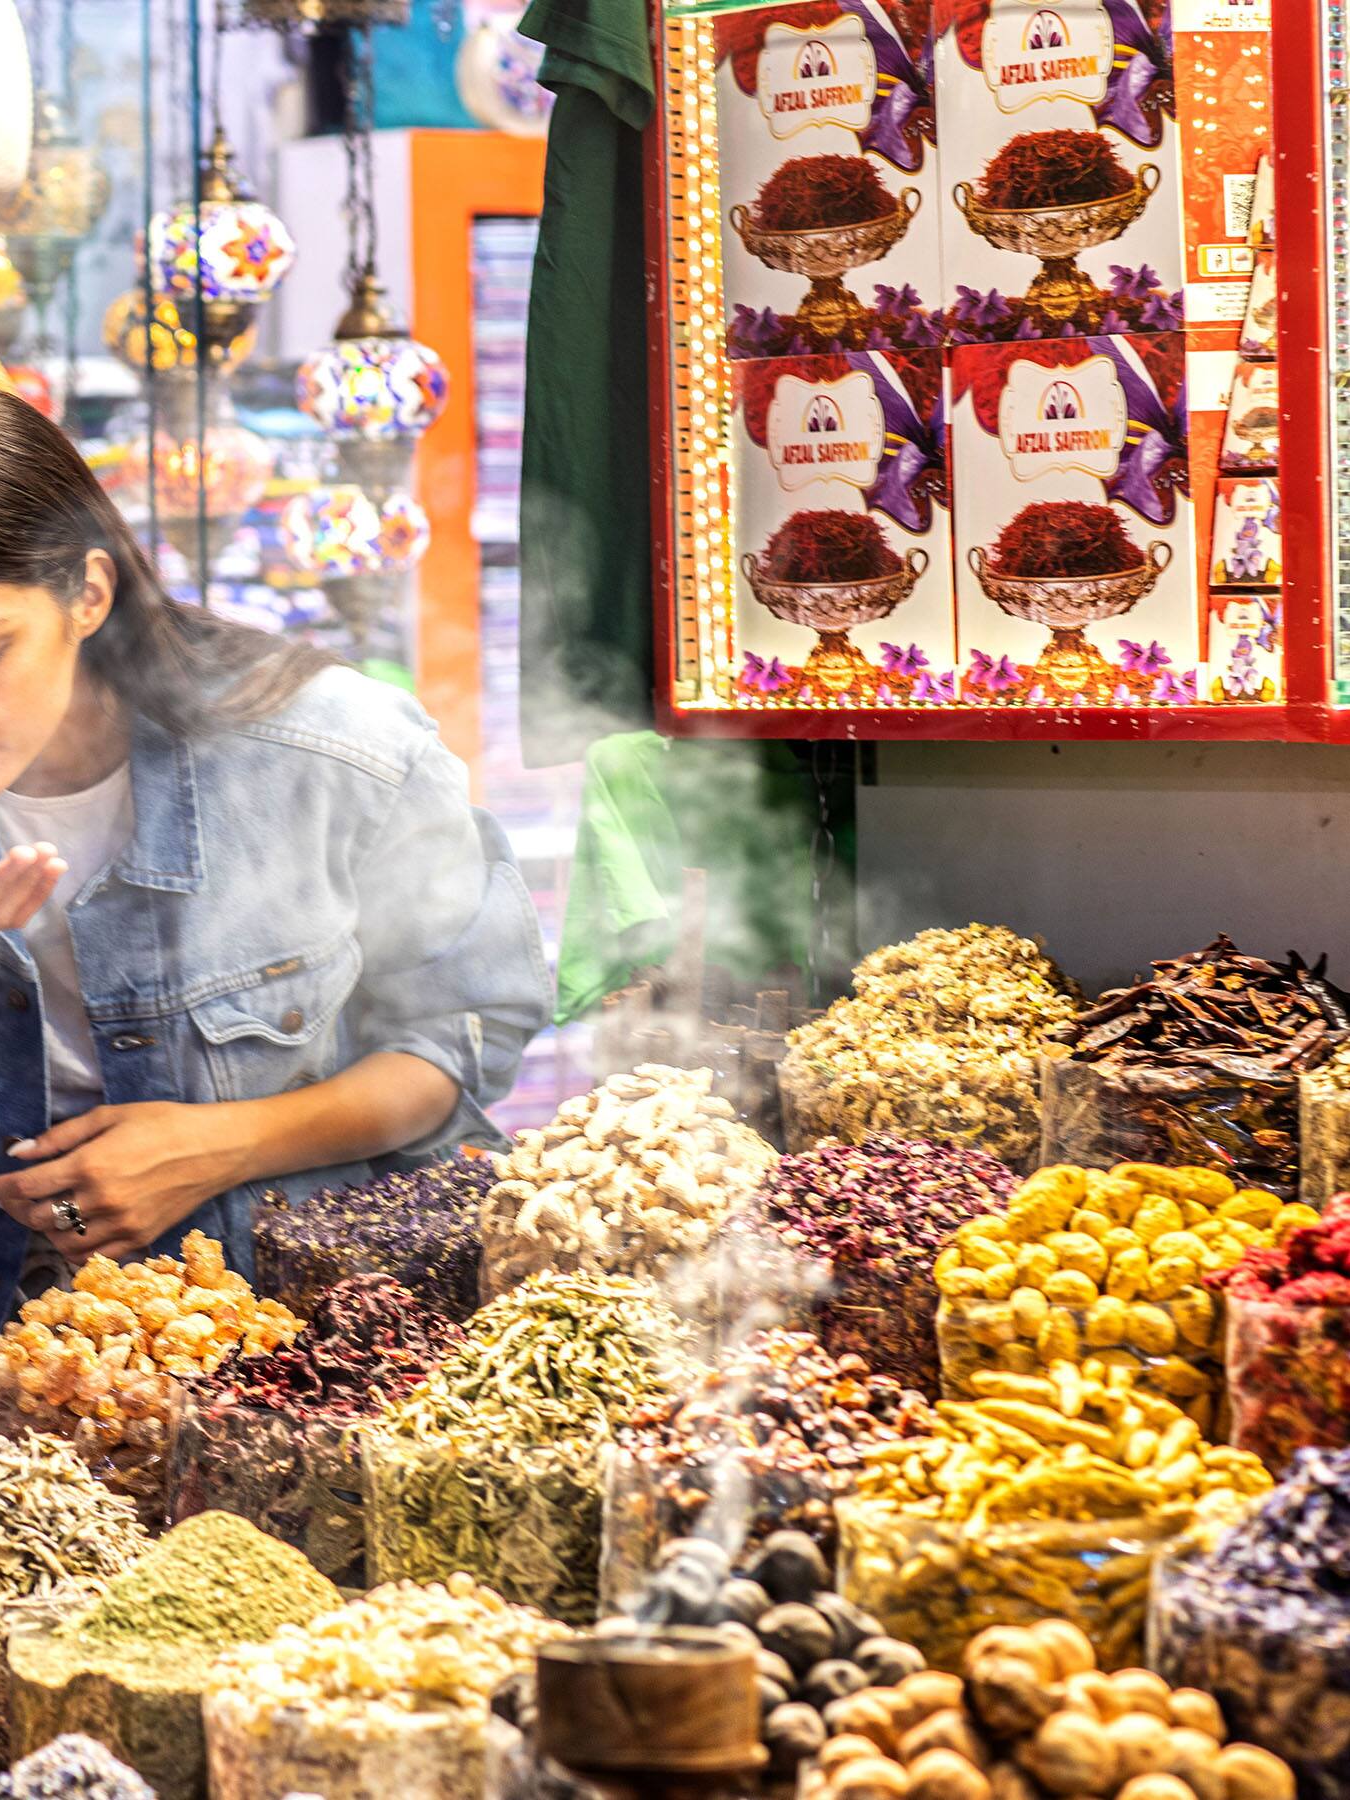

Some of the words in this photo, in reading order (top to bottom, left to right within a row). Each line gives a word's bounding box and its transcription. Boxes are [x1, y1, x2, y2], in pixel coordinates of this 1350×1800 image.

[1001, 63, 1037, 86] AFZAL
[1041, 55, 1099, 81] SAFFRON
[774, 90, 807, 112] AFZAL
[810, 84, 863, 108] SAFFRON
[782, 444, 814, 464] AFZAL
[817, 441, 869, 463] SAFFRON
[1017, 432, 1051, 453] AFZAL
[1055, 429, 1111, 451] SAFFRON
